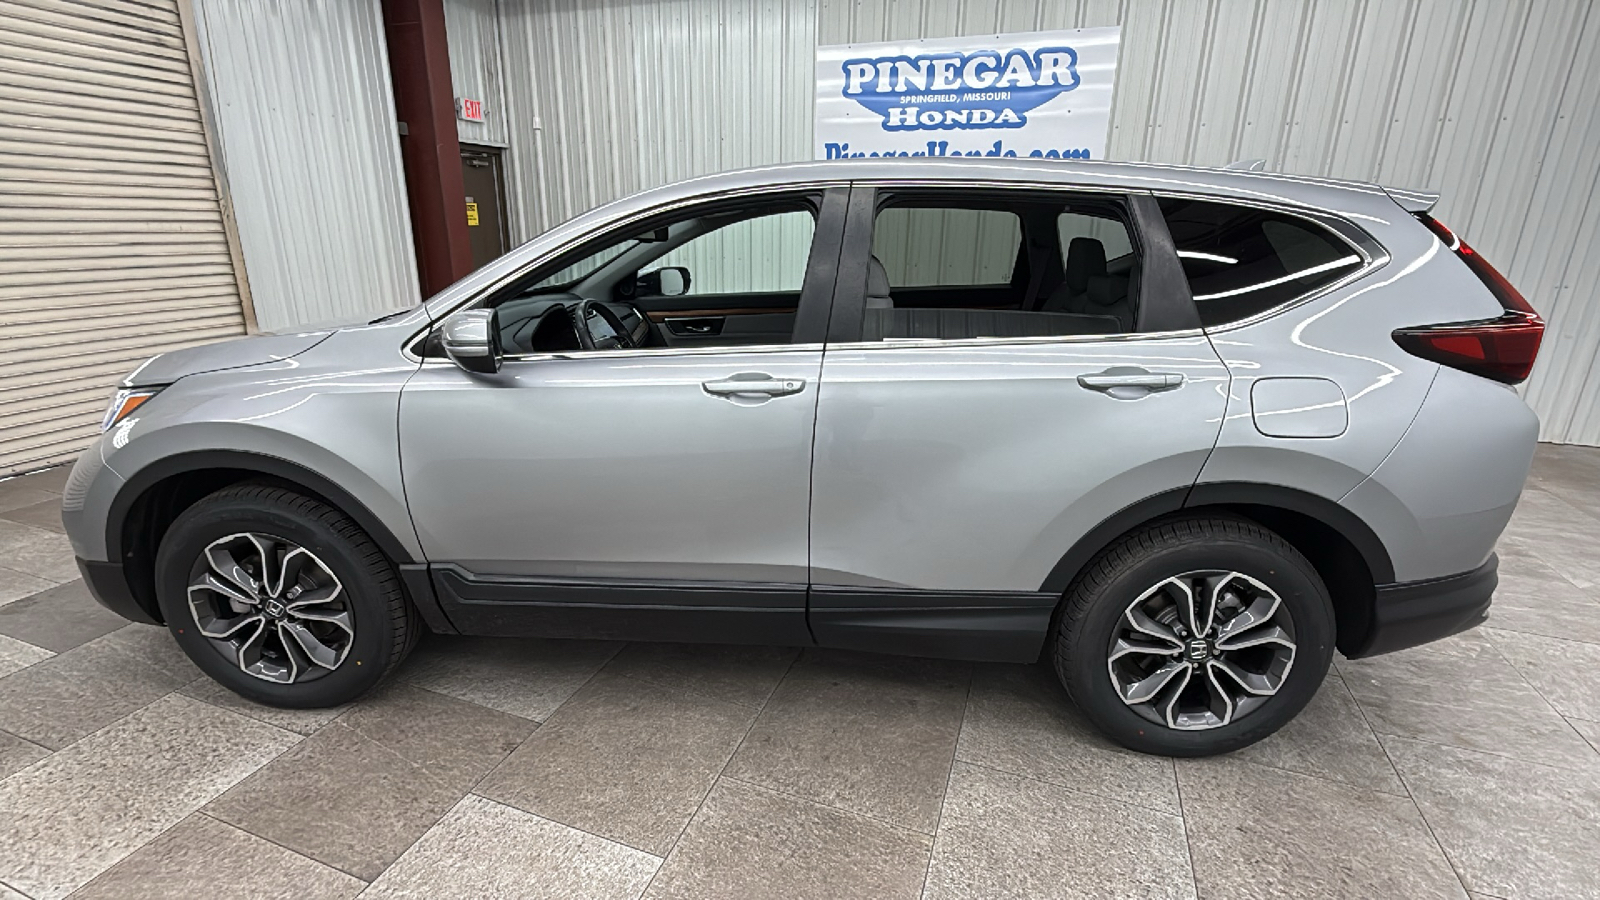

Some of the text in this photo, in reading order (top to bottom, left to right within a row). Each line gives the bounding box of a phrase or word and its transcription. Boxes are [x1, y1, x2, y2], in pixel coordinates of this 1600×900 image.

[847, 51, 1077, 95] PINEGAR
[900, 91, 1011, 104] SPRINGFIELD, MISSOURI
[464, 99, 481, 120] EXIT
[887, 107, 1022, 126] HONDA
